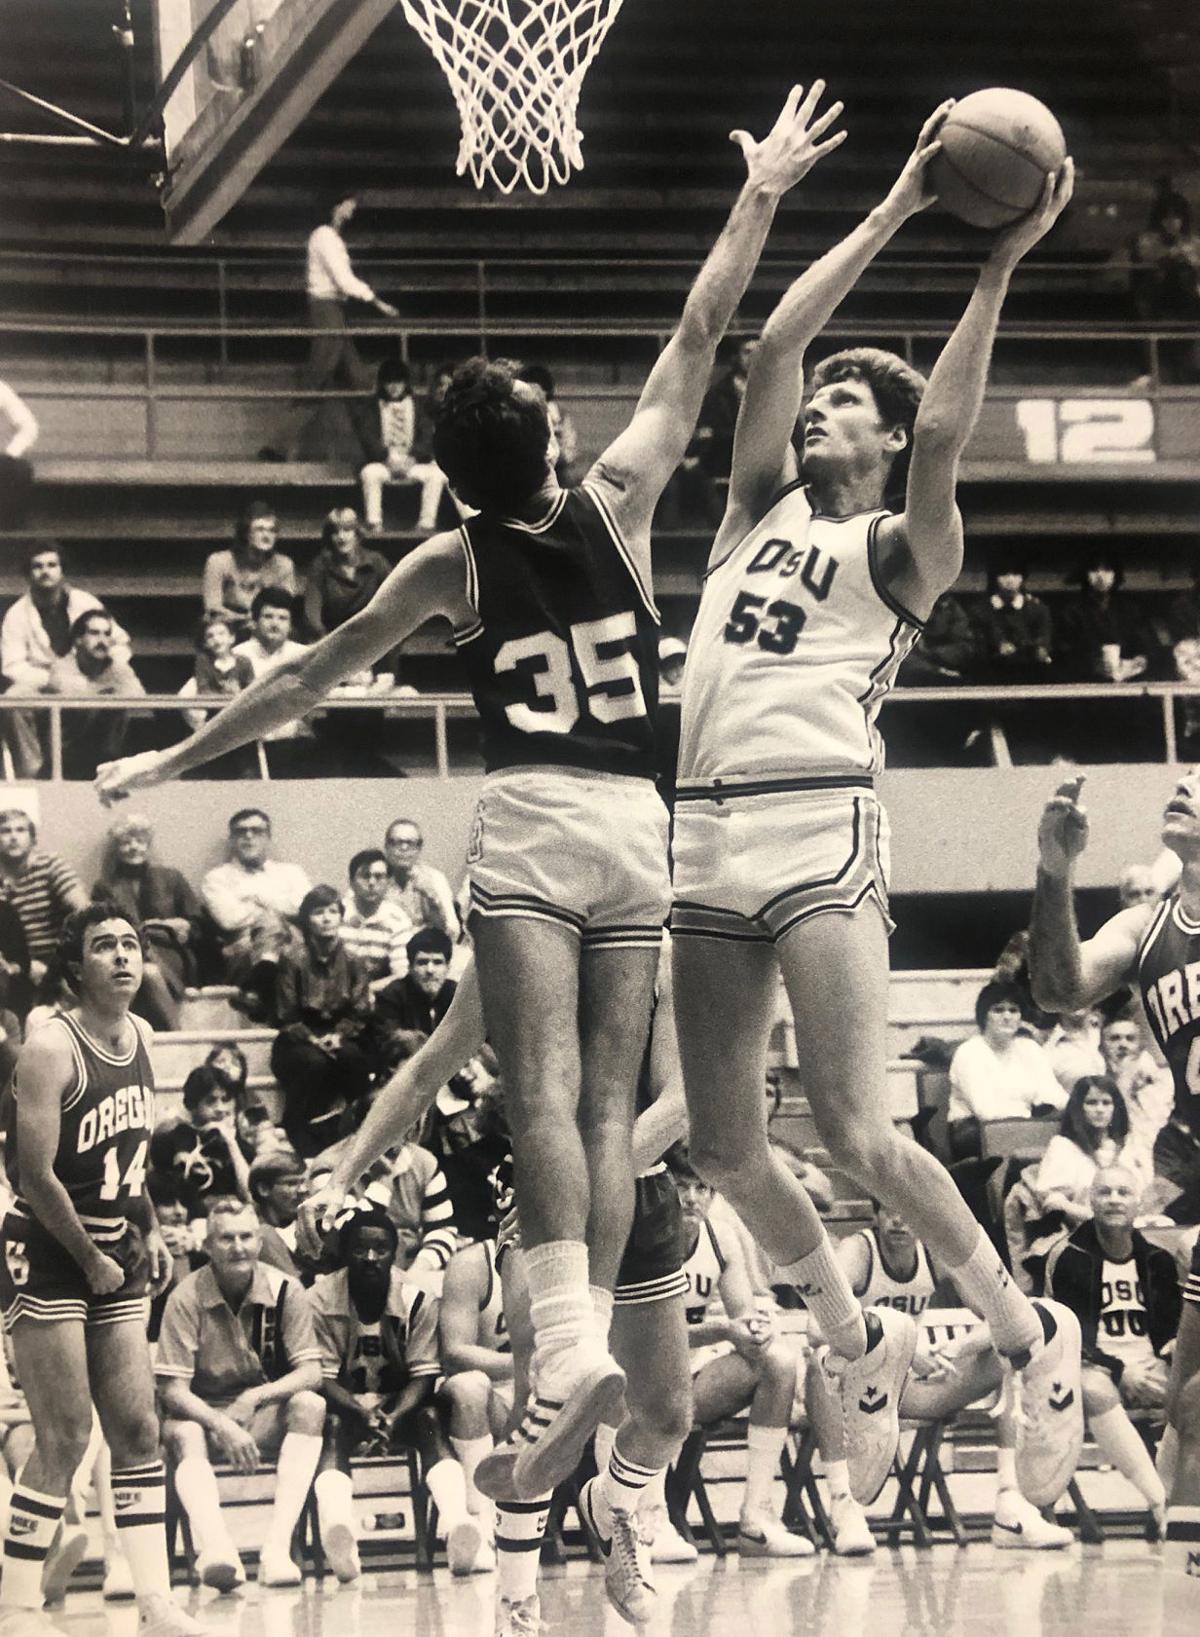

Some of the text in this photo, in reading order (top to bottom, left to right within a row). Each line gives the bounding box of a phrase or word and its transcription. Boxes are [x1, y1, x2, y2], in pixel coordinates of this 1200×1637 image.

[1016, 400, 1156, 463] 12
[746, 538, 839, 603] OSU
[723, 590, 807, 655] 53
[494, 610, 647, 734] 35
[100, 1140, 148, 1200] 14
